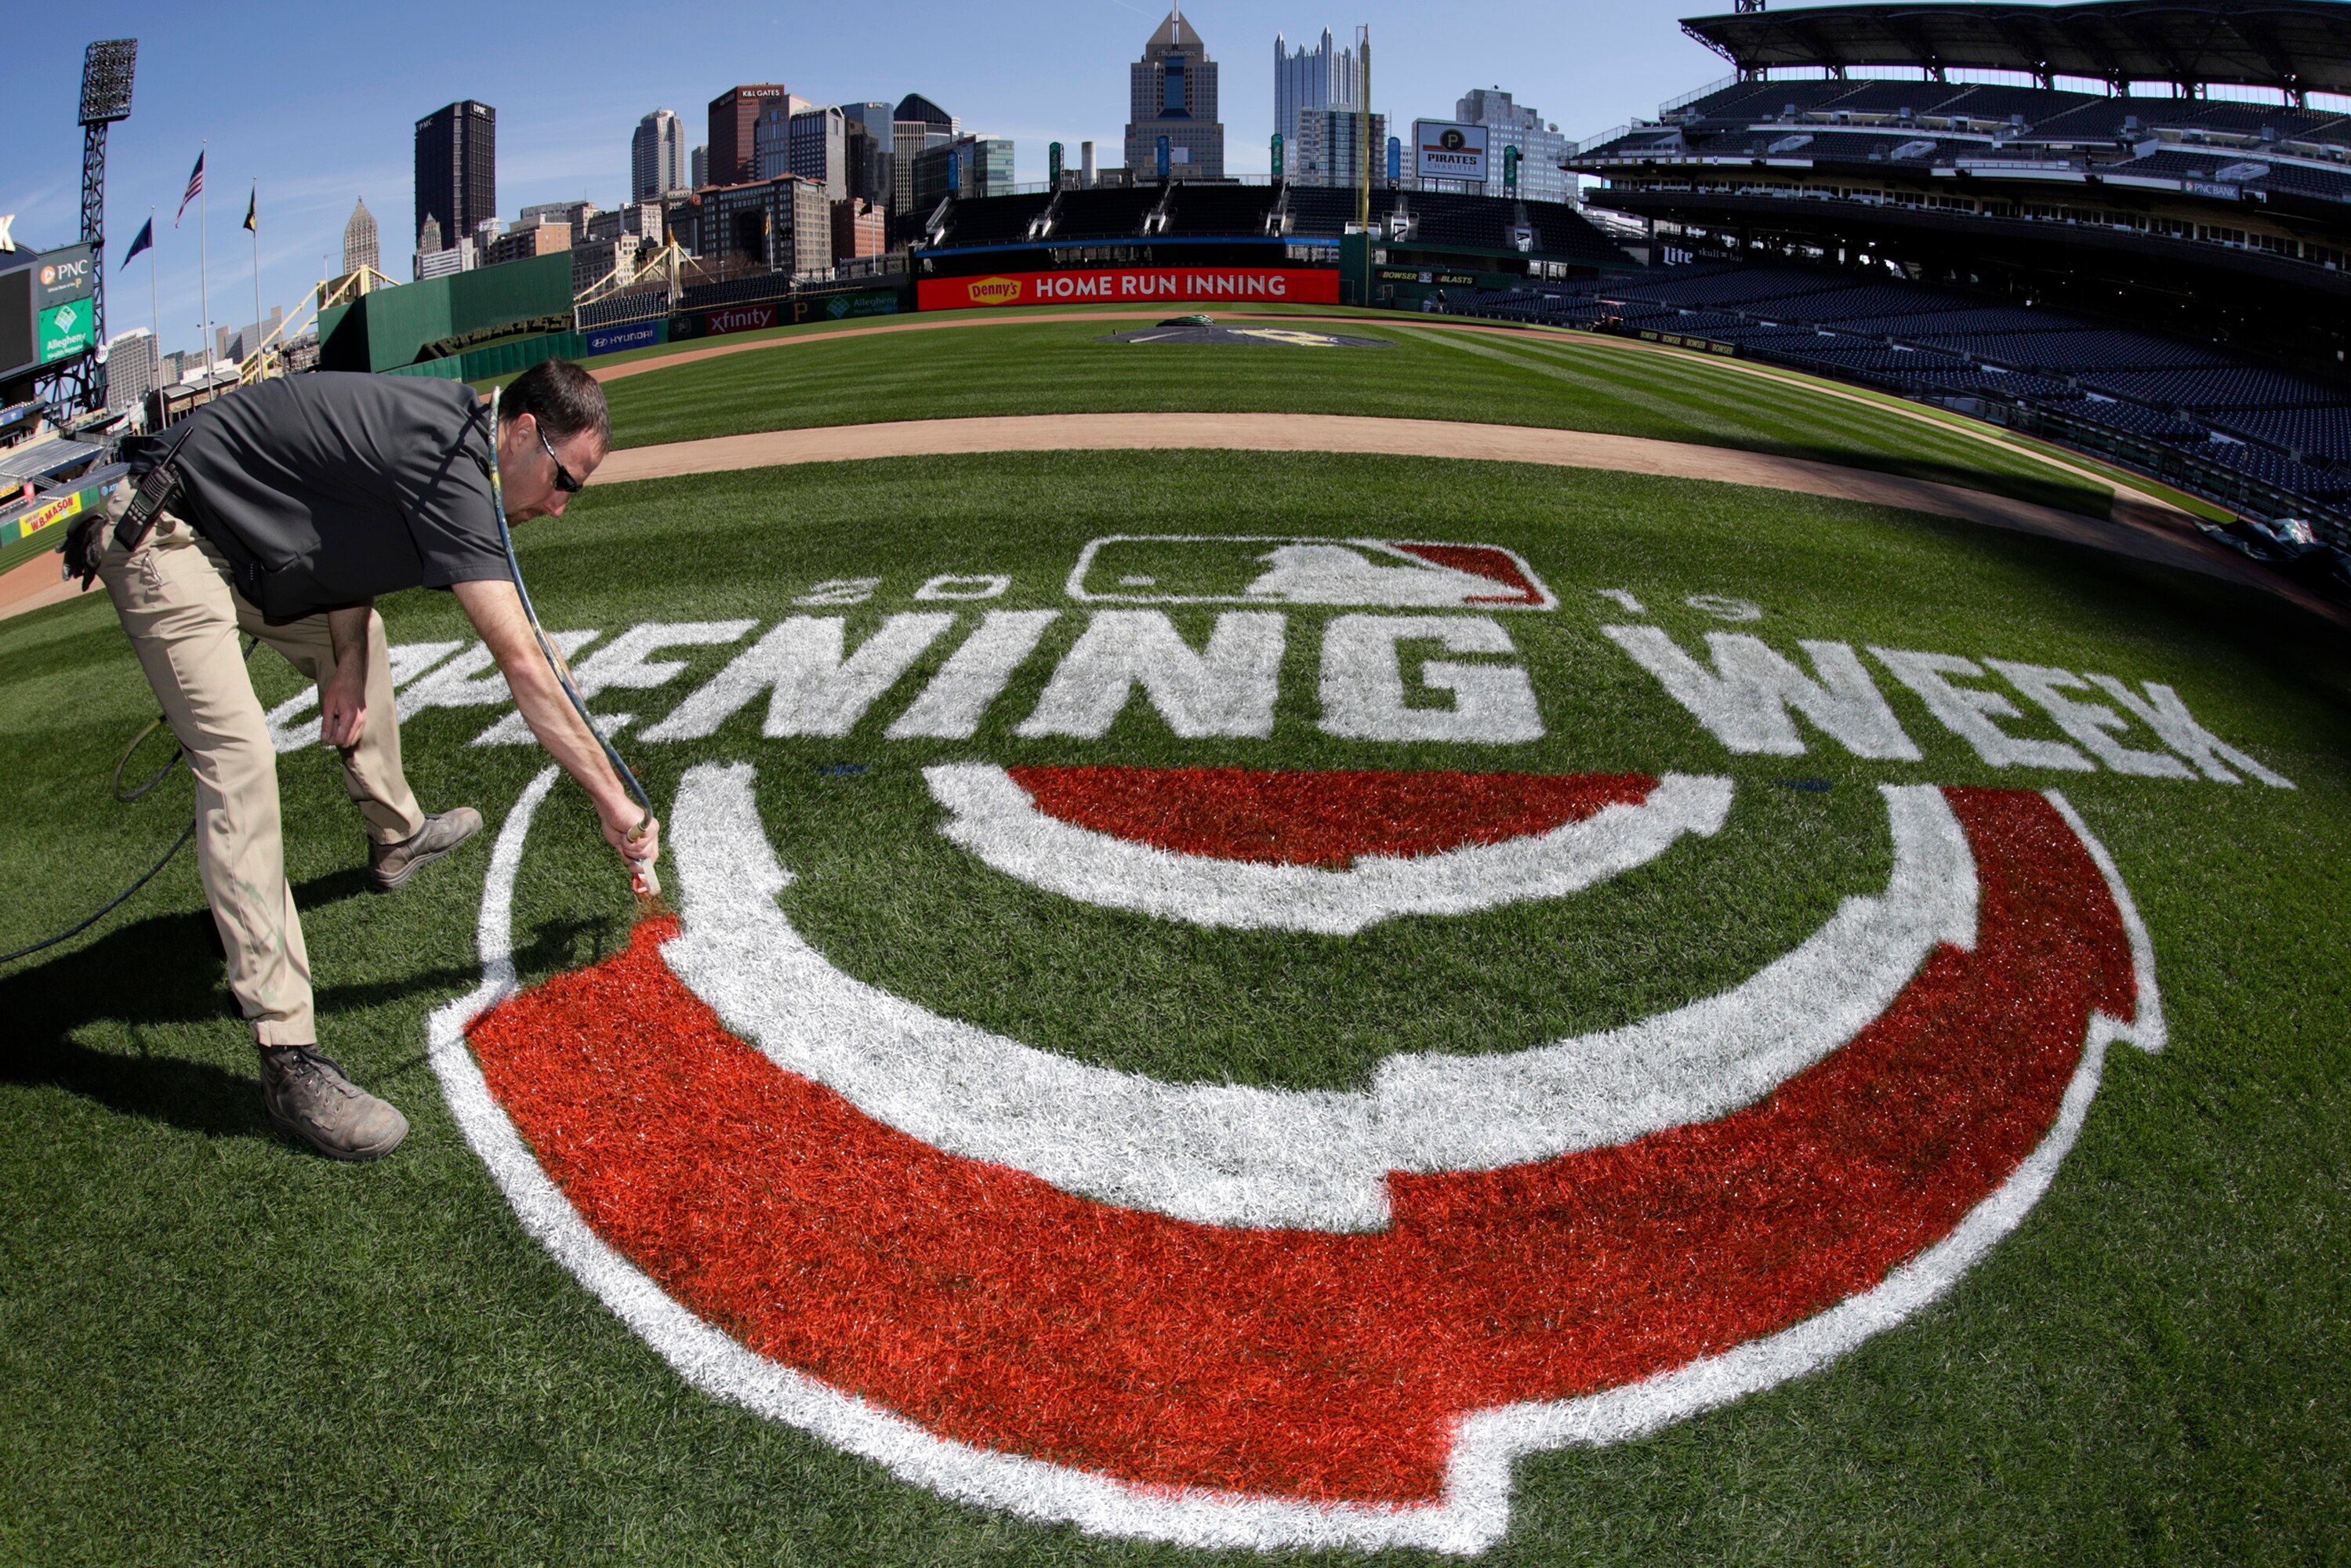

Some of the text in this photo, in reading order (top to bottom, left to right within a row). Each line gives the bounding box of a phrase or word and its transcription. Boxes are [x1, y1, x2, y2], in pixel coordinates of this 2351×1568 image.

[473, 103, 487, 115] UPMC
[1428, 154, 1477, 165] PIRATES
[1428, 162, 1478, 172] CHARITIES
[2194, 183, 2236, 197] PNC BANK
[1662, 245, 1694, 266] Lite
[1698, 247, 1743, 262] skull bar
[57, 260, 88, 281] PNC
[1382, 271, 1417, 280] BOWSER
[1441, 275, 1474, 284] BLASTS
[971, 281, 1018, 298] Denny's
[1036, 274, 1286, 297] HOME RUN INNING
[854, 296, 898, 307] Allegheny
[711, 308, 772, 332] xfinity
[46, 332, 86, 351] Allegheny
[610, 329, 654, 344] HYUNDAI
[1640, 330, 1658, 340] BOWSER
[1662, 334, 1682, 345] BOWSER
[1686, 338, 1706, 350] BOWSER
[1711, 343, 1733, 355] BOWSER
[31, 496, 74, 532] W.B.MASON
[1598, 623, 2298, 789] WEEK
